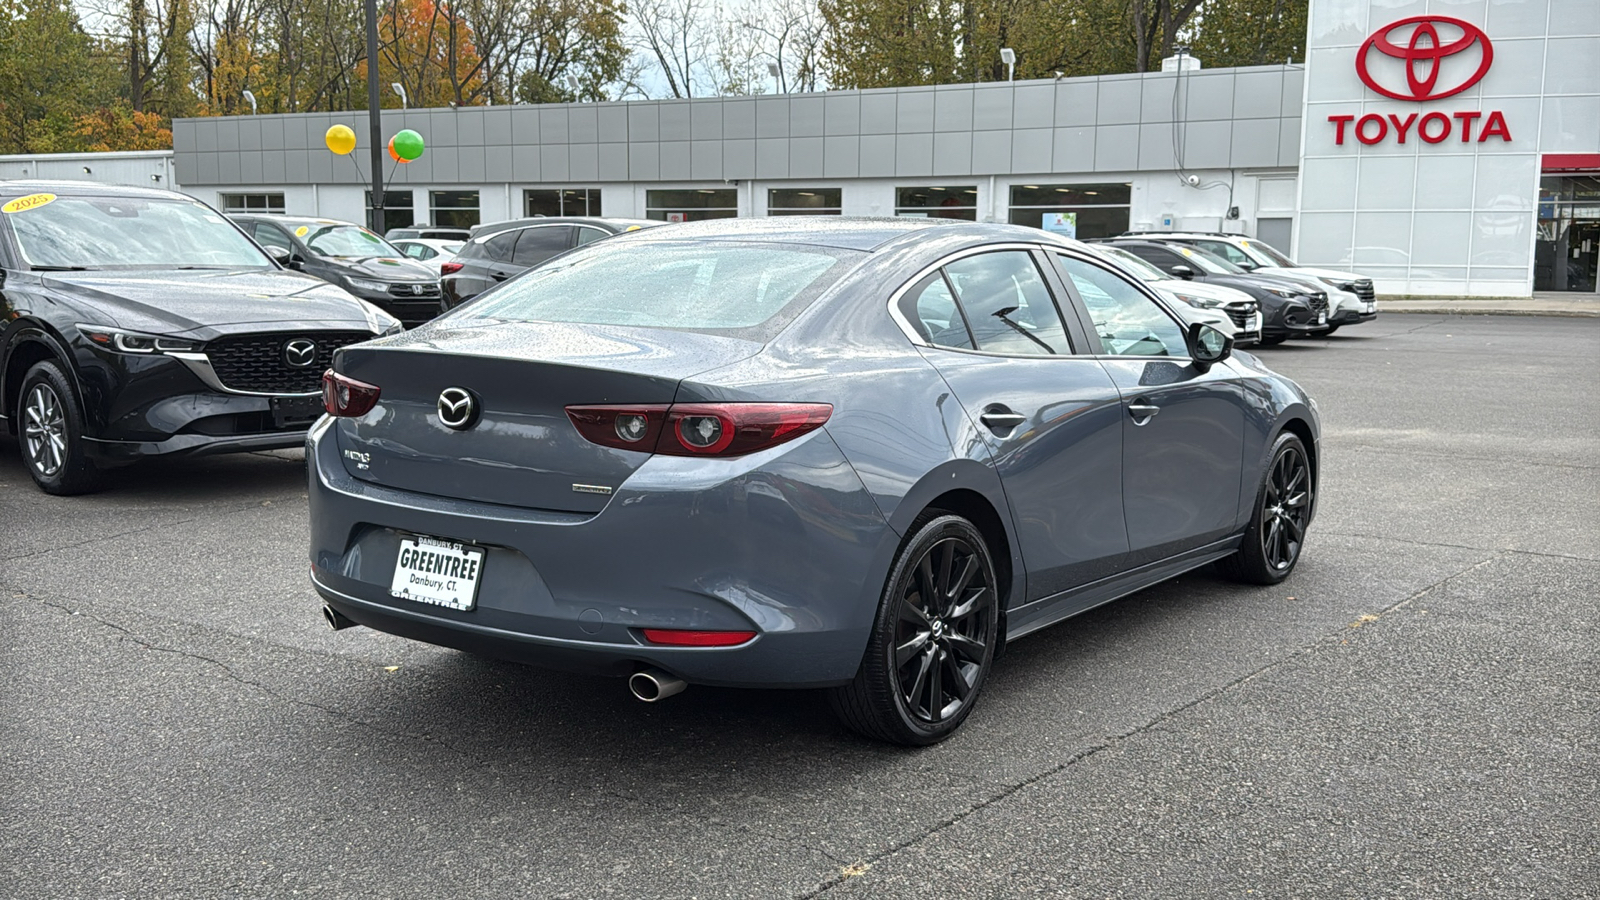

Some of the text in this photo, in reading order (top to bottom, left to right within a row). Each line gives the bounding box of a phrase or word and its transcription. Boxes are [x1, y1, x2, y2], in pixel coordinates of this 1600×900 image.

[1328, 111, 1512, 145] TOYOTA
[12, 195, 48, 210] 2025
[418, 537, 452, 550] DANBURY,
[400, 548, 477, 580] GREENTREE
[409, 573, 457, 591] Danbury, CT.
